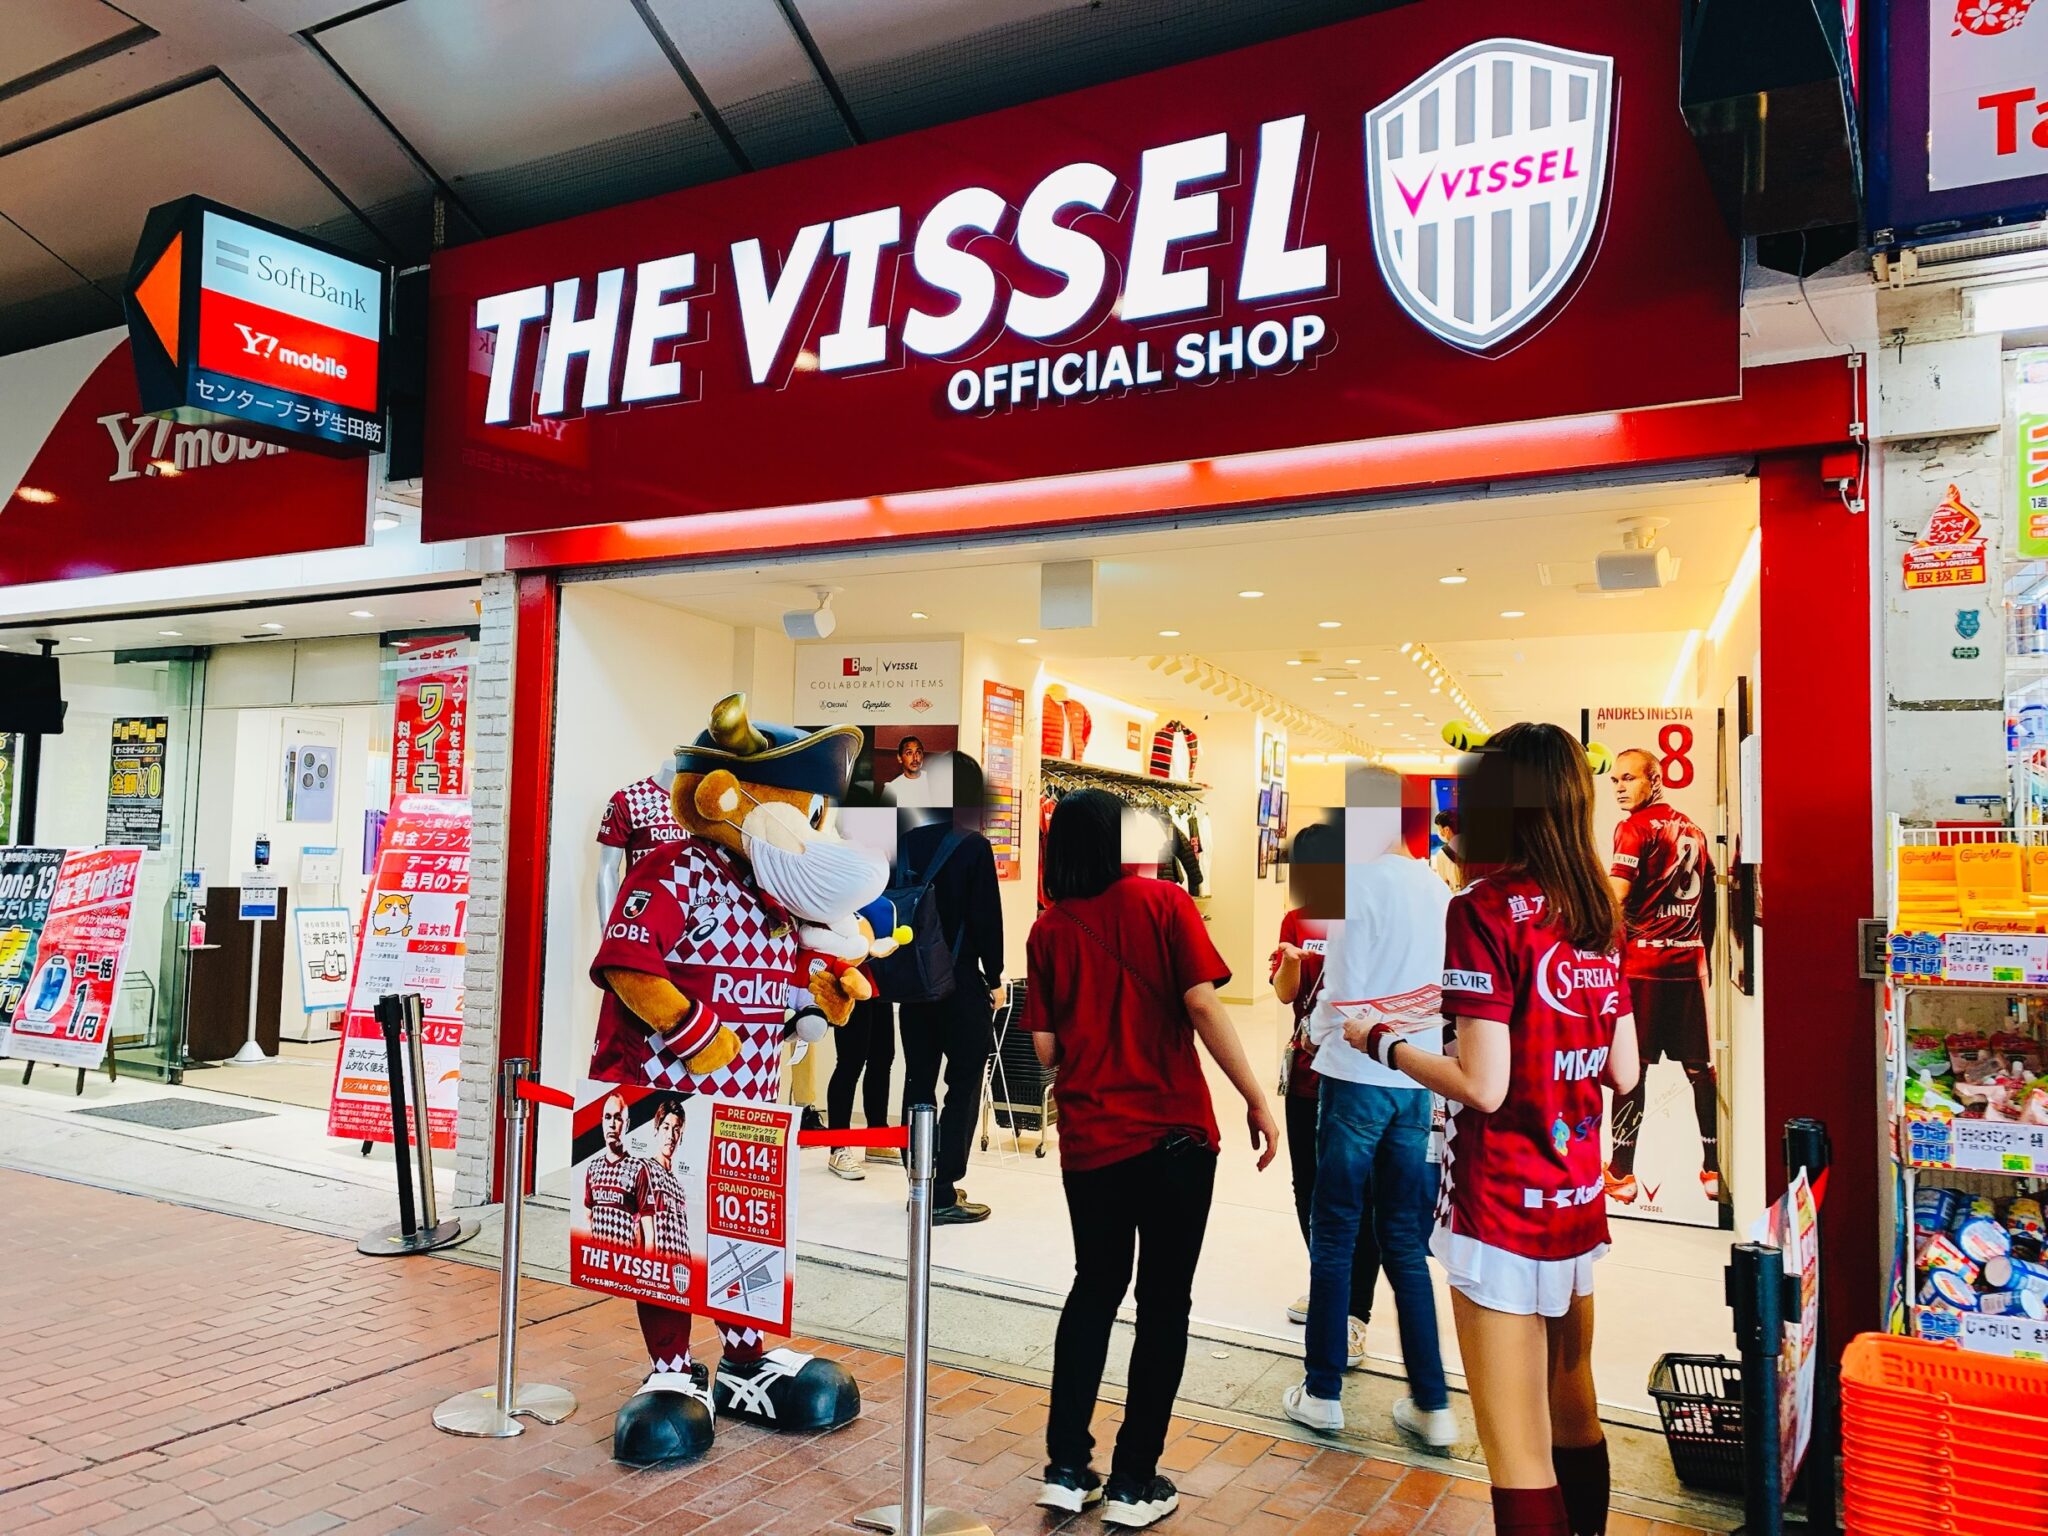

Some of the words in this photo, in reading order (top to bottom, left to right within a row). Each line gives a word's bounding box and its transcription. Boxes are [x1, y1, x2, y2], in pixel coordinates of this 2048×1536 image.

[1441, 147, 1579, 202] VISSEL
[476, 252, 696, 425] THE
[731, 114, 1327, 385] VISSEL
[257, 255, 367, 313] SoftBank
[234, 322, 279, 359] Y!
[279, 348, 348, 380] mobile
[947, 341, 1162, 412] OFFICIAL
[1175, 314, 1326, 379] SHOP
[196, 379, 382, 443] センタープラザ生田筋
[97, 412, 174, 482] Y!
[1916, 568, 1973, 584] 取扱店
[892, 661, 919, 671] VISSEL
[810, 680, 904, 690] COLLABORATION
[911, 679, 944, 688] ITEMS
[1597, 707, 1645, 720] ANDRES
[1647, 707, 1694, 720] INIESTA
[1597, 722, 1607, 730] MF
[1658, 723, 1694, 789] 8
[35, 866, 58, 900] 13
[715, 894, 732, 905] toto
[418, 922, 451, 937] 最大約
[606, 922, 650, 943] KOBE
[417, 943, 440, 952] シンプル
[440, 944, 447, 953] S
[1306, 942, 1325, 952] THE
[1890, 933, 1943, 953] 今だけ
[1948, 941, 2029, 957] カロリーメイトブロック
[88, 957, 115, 980] 一括
[1442, 971, 1490, 991] DEVIR
[728, 1108, 745, 1120] PRE
[747, 1111, 774, 1124] OPEN
[720, 1129, 738, 1139] VISSEL
[717, 1140, 770, 1172] 10.14
[719, 1168, 738, 1177] 11:00
[748, 1172, 770, 1182] 20:00
[717, 1182, 749, 1196] GRAND
[750, 1187, 776, 1200] OPEN
[715, 1194, 769, 1226] 10.15
[1639, 1204, 1664, 1213] VISSEL
[719, 1220, 738, 1230] 11:00
[747, 1225, 770, 1236] 20:00
[581, 1245, 609, 1270] THE
[612, 1252, 671, 1284] VISSEL
[636, 1278, 657, 1288] OFFICIAL
[656, 1283, 671, 1291] SHOP
[1965, 1321, 2022, 1341] じゃがりこ
